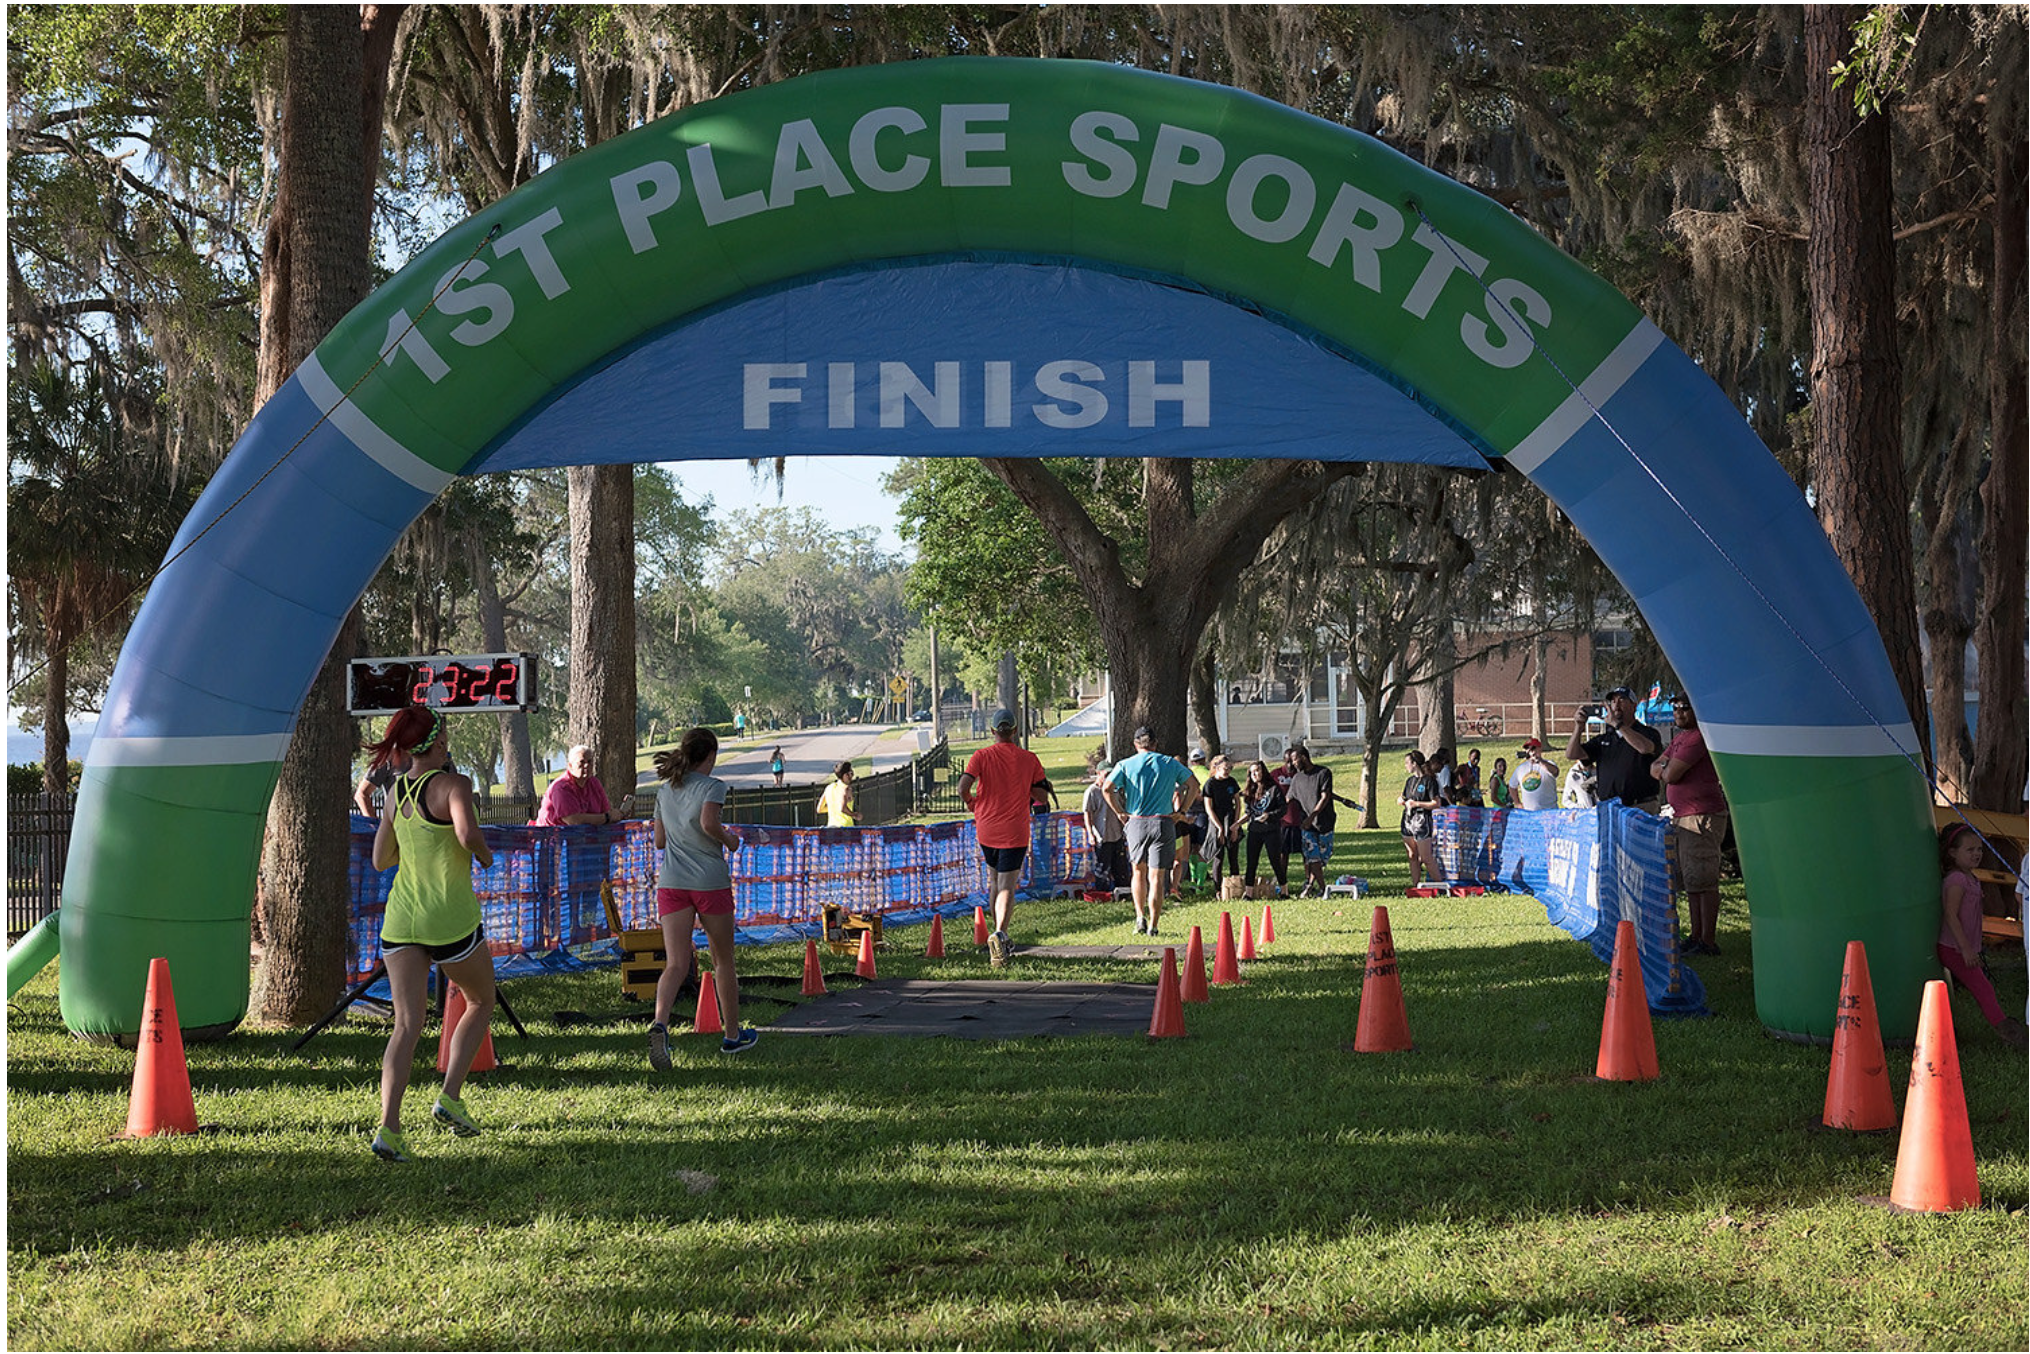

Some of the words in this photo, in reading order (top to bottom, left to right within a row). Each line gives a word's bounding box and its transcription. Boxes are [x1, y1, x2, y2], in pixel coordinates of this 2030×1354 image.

[378, 206, 572, 384] 1ST
[609, 103, 1012, 254] PLACE
[1061, 111, 1552, 369] SPORTS
[743, 360, 1211, 429] FINISH
[412, 663, 517, 704] 23:22
